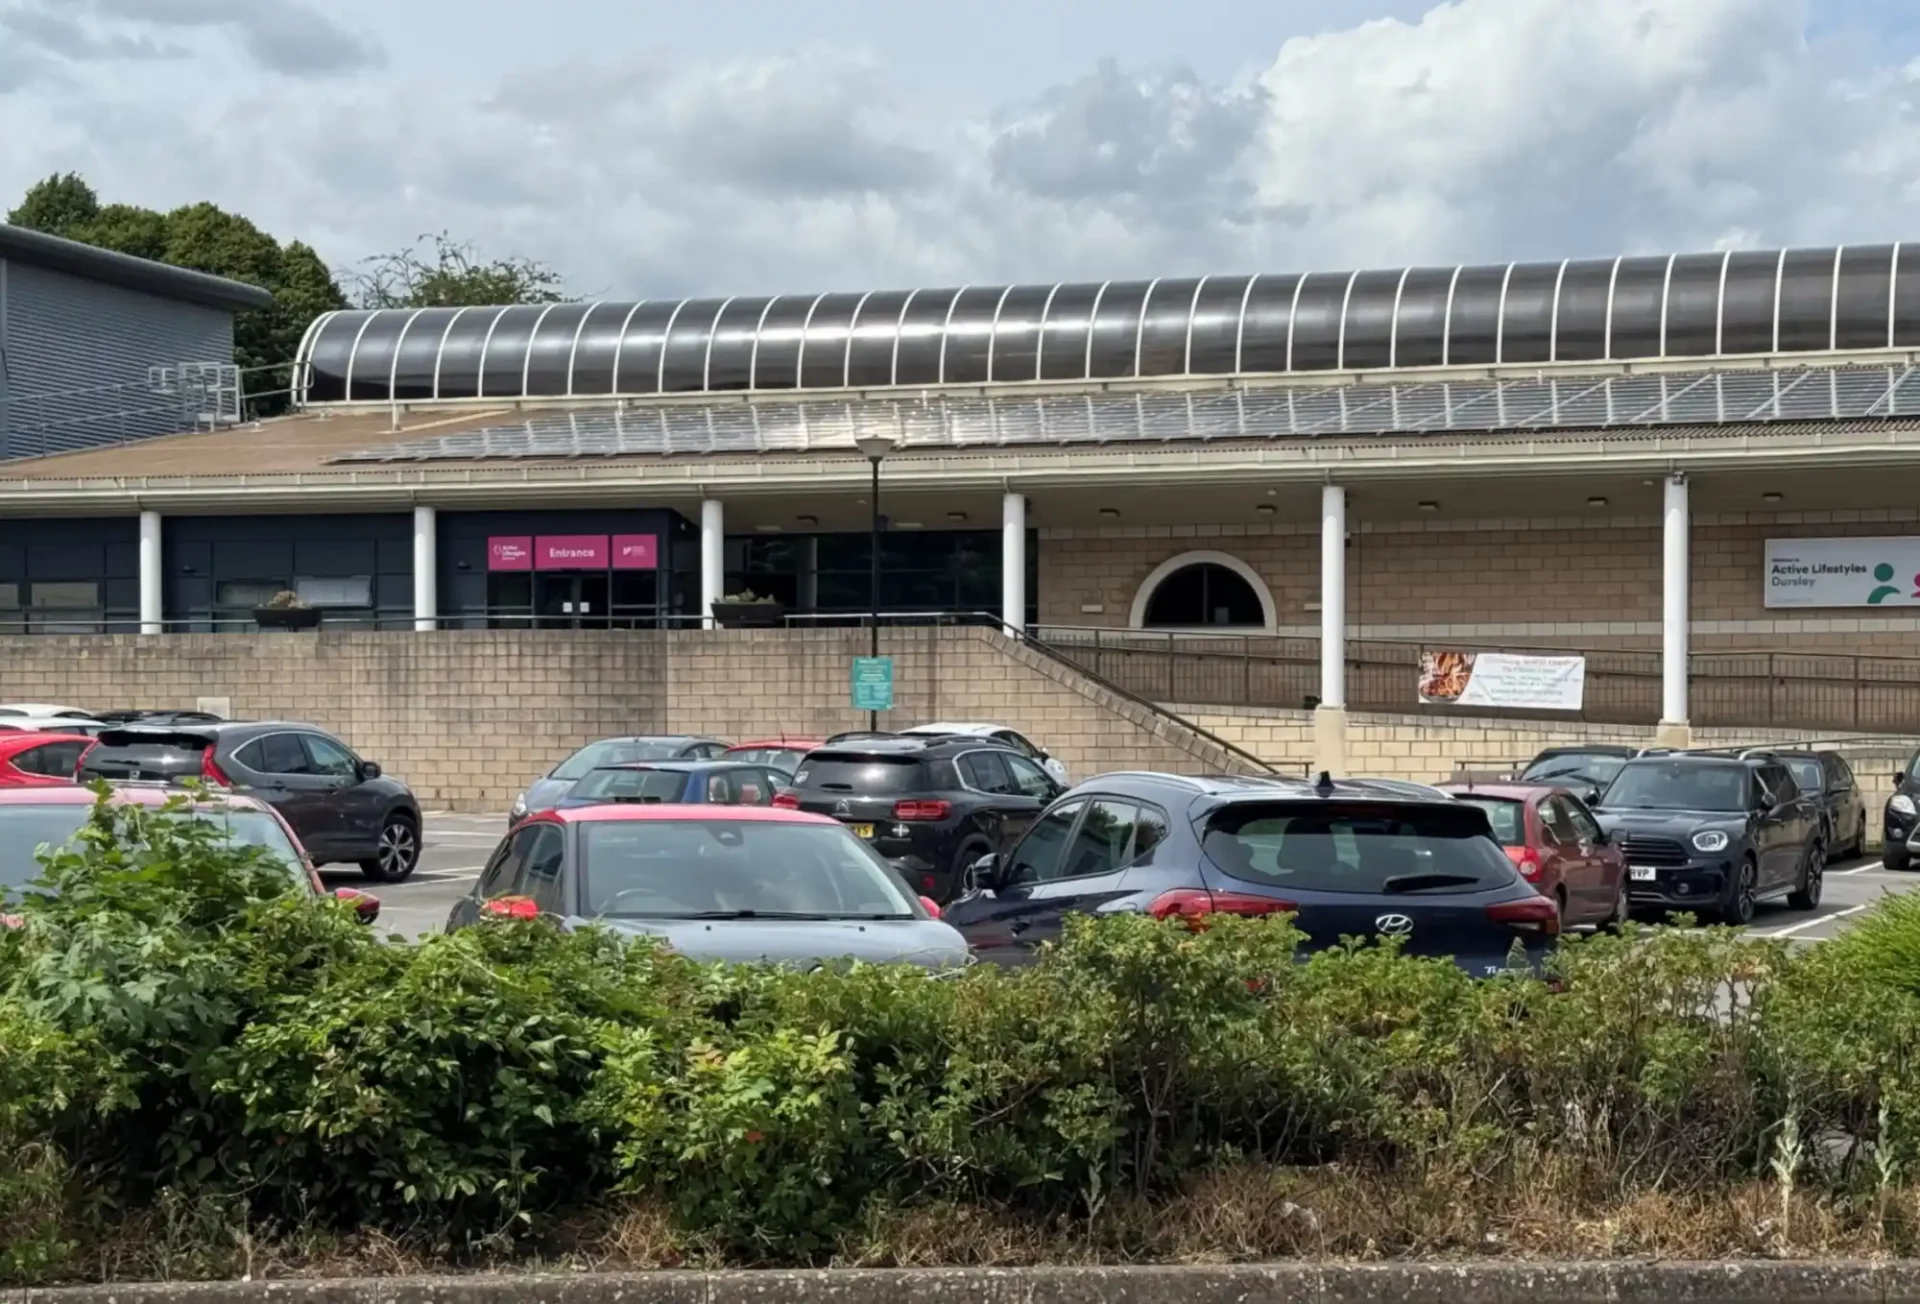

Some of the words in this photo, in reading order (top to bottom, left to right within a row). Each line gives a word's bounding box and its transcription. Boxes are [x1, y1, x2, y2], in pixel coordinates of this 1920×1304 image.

[549, 548, 596, 558] Entrance
[1771, 564, 1809, 574] Active
[1811, 563, 1868, 576] Lifestyles
[1771, 576, 1816, 588] Dursley
